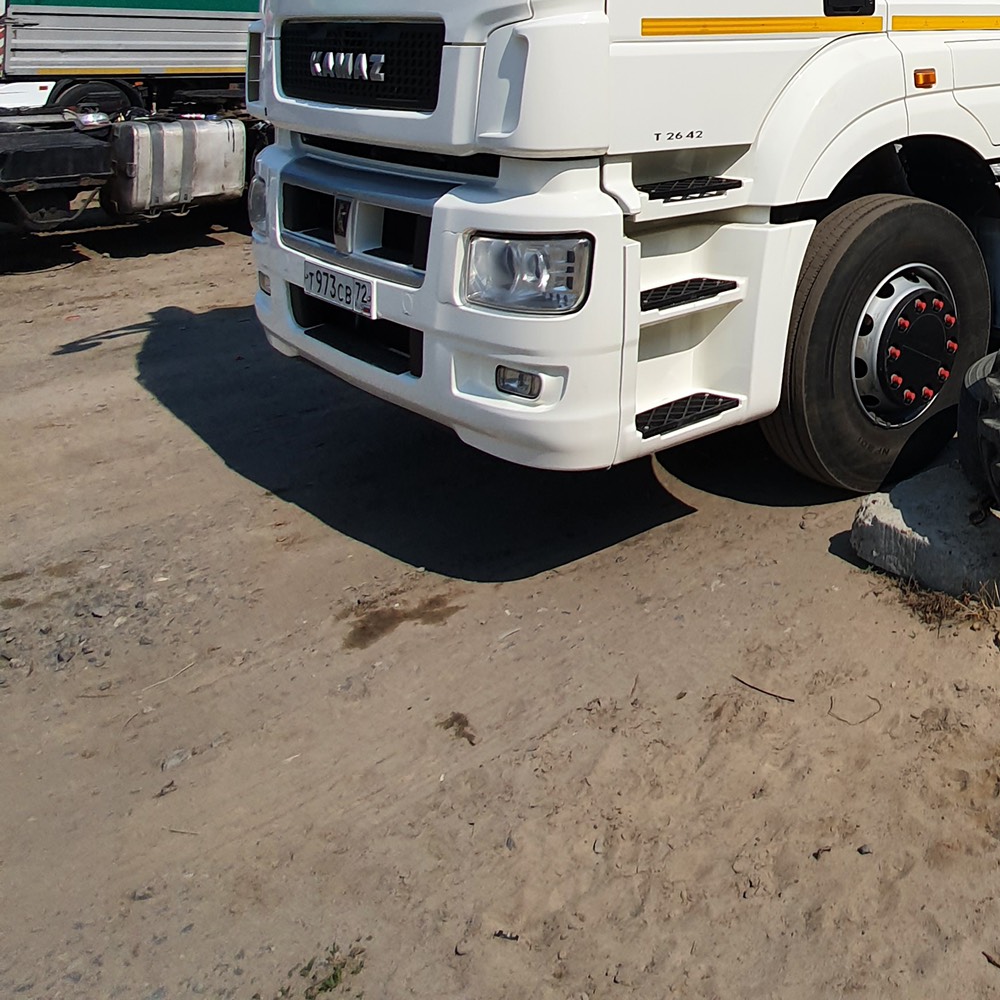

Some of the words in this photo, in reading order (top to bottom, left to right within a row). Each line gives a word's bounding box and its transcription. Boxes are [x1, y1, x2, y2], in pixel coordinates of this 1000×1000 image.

[309, 51, 386, 82] KAMAZ
[653, 132, 662, 141] T
[666, 130, 703, 141] 2642
[355, 281, 367, 307] 72
